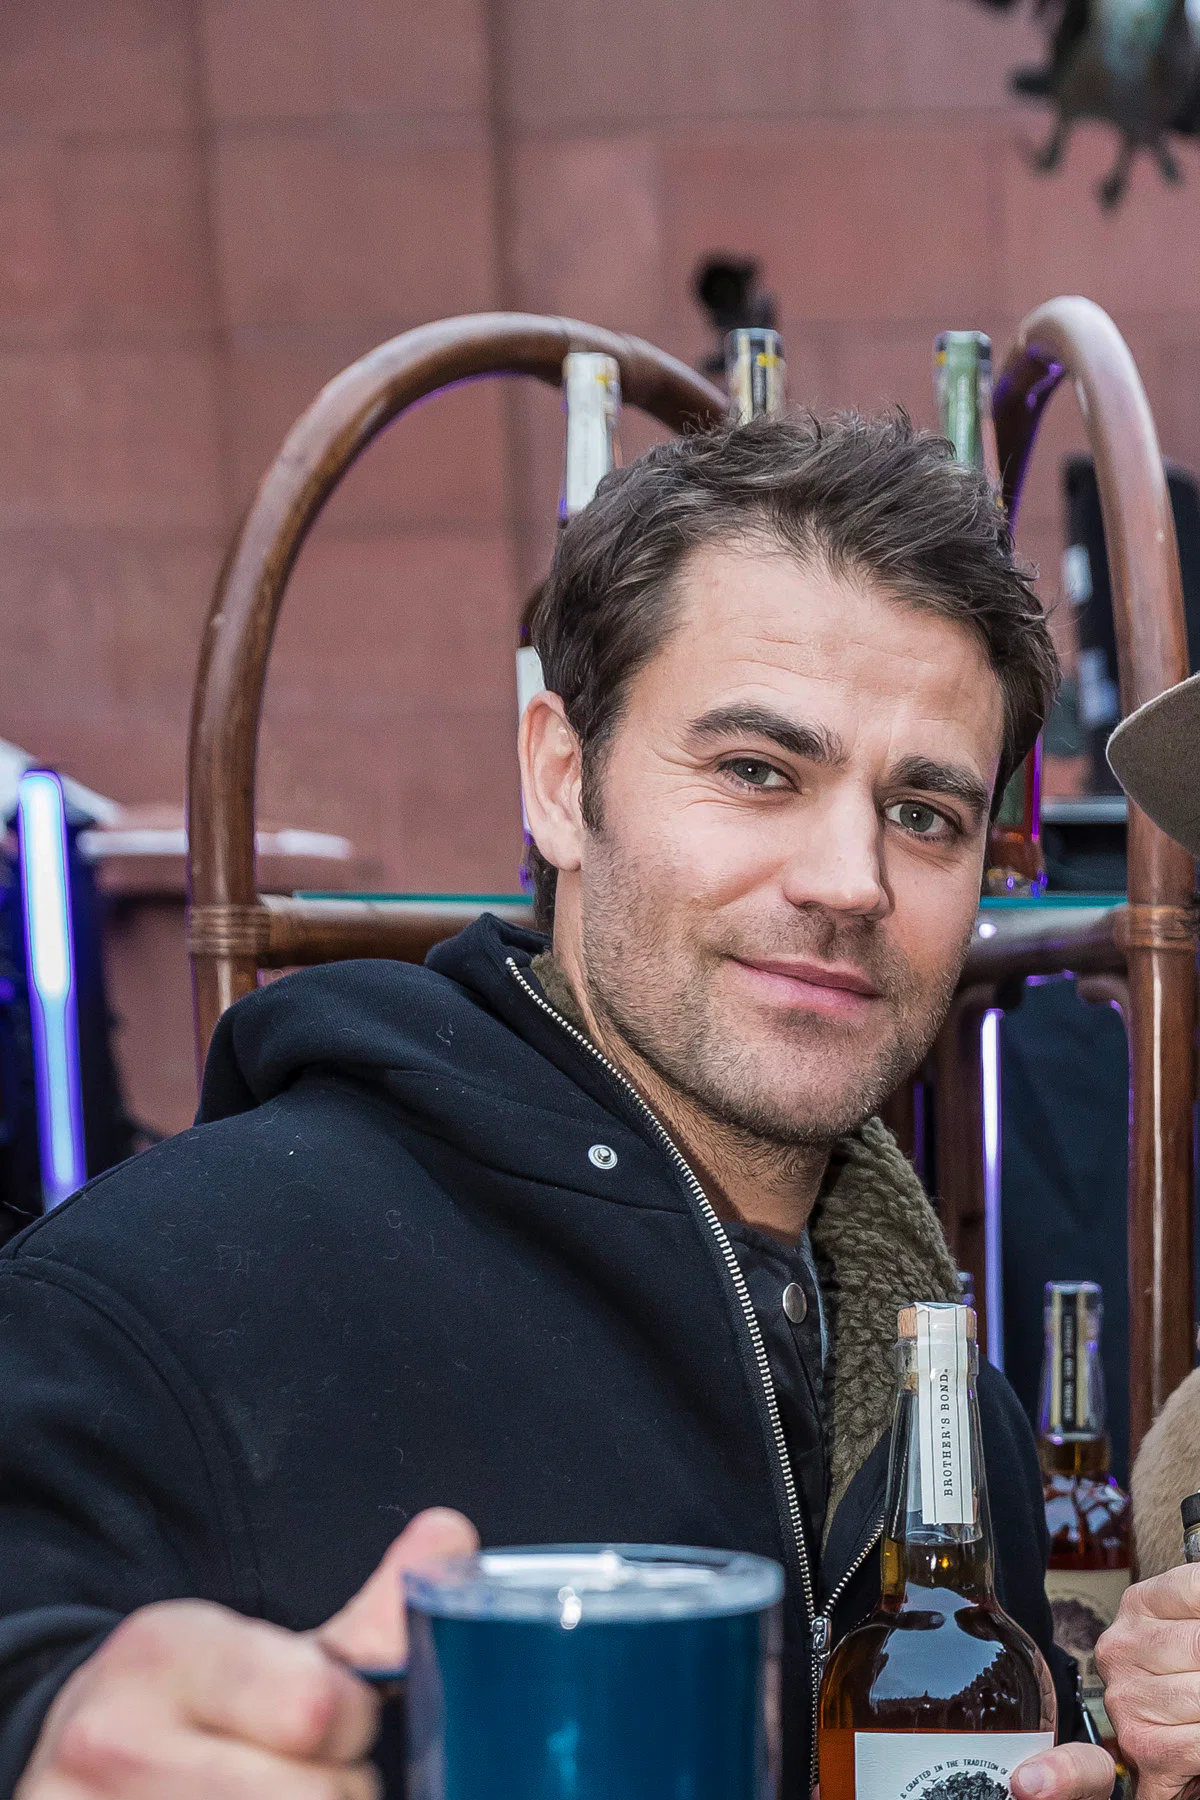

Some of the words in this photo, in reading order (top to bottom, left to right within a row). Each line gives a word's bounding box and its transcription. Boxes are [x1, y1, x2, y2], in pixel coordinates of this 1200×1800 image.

[940, 1417, 953, 1497] BROTHER'S
[905, 1770, 932, 1792] CRAFTED
[934, 1764, 944, 1773] IN
[946, 1759, 959, 1769] THE
[963, 1758, 1000, 1771] TRADITION
